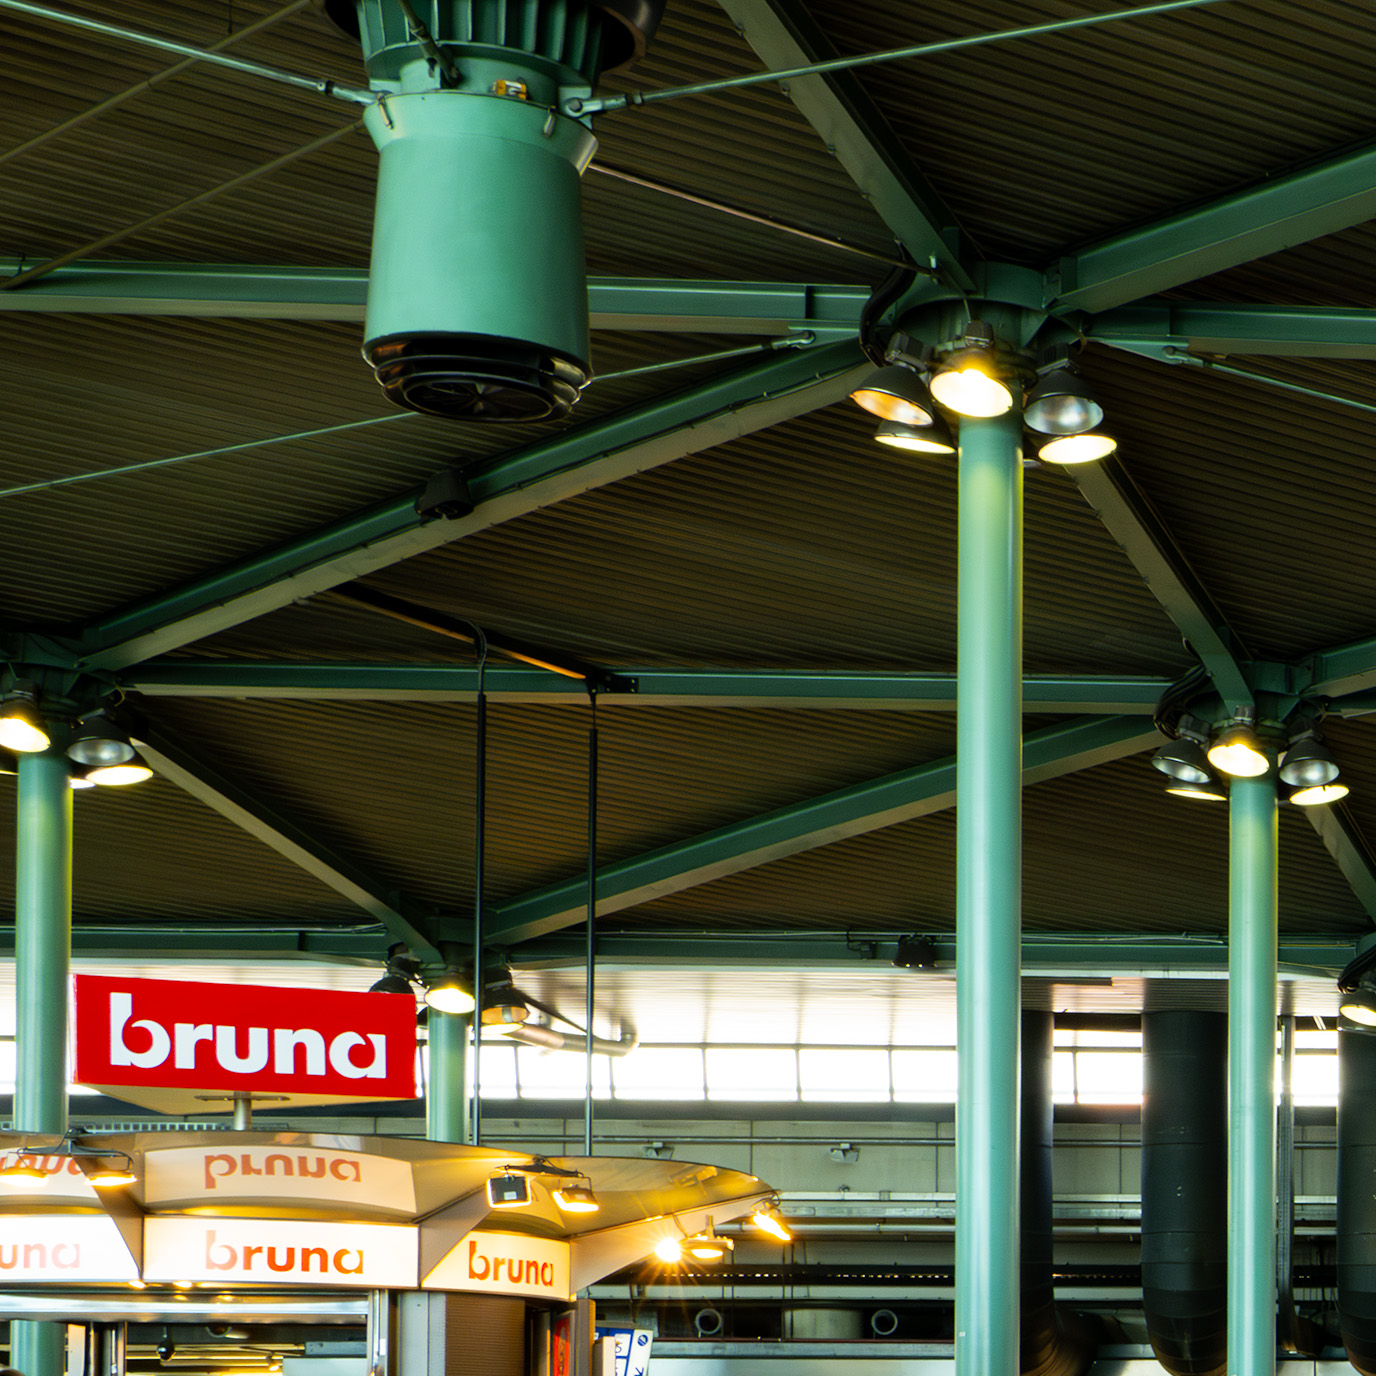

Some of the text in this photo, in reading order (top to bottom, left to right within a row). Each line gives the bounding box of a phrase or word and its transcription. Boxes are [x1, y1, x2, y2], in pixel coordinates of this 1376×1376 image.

[110, 992, 387, 1080] bruna
[0, 1243, 80, 1269] una
[205, 1230, 364, 1275] bruna
[468, 1241, 554, 1287] bruna
